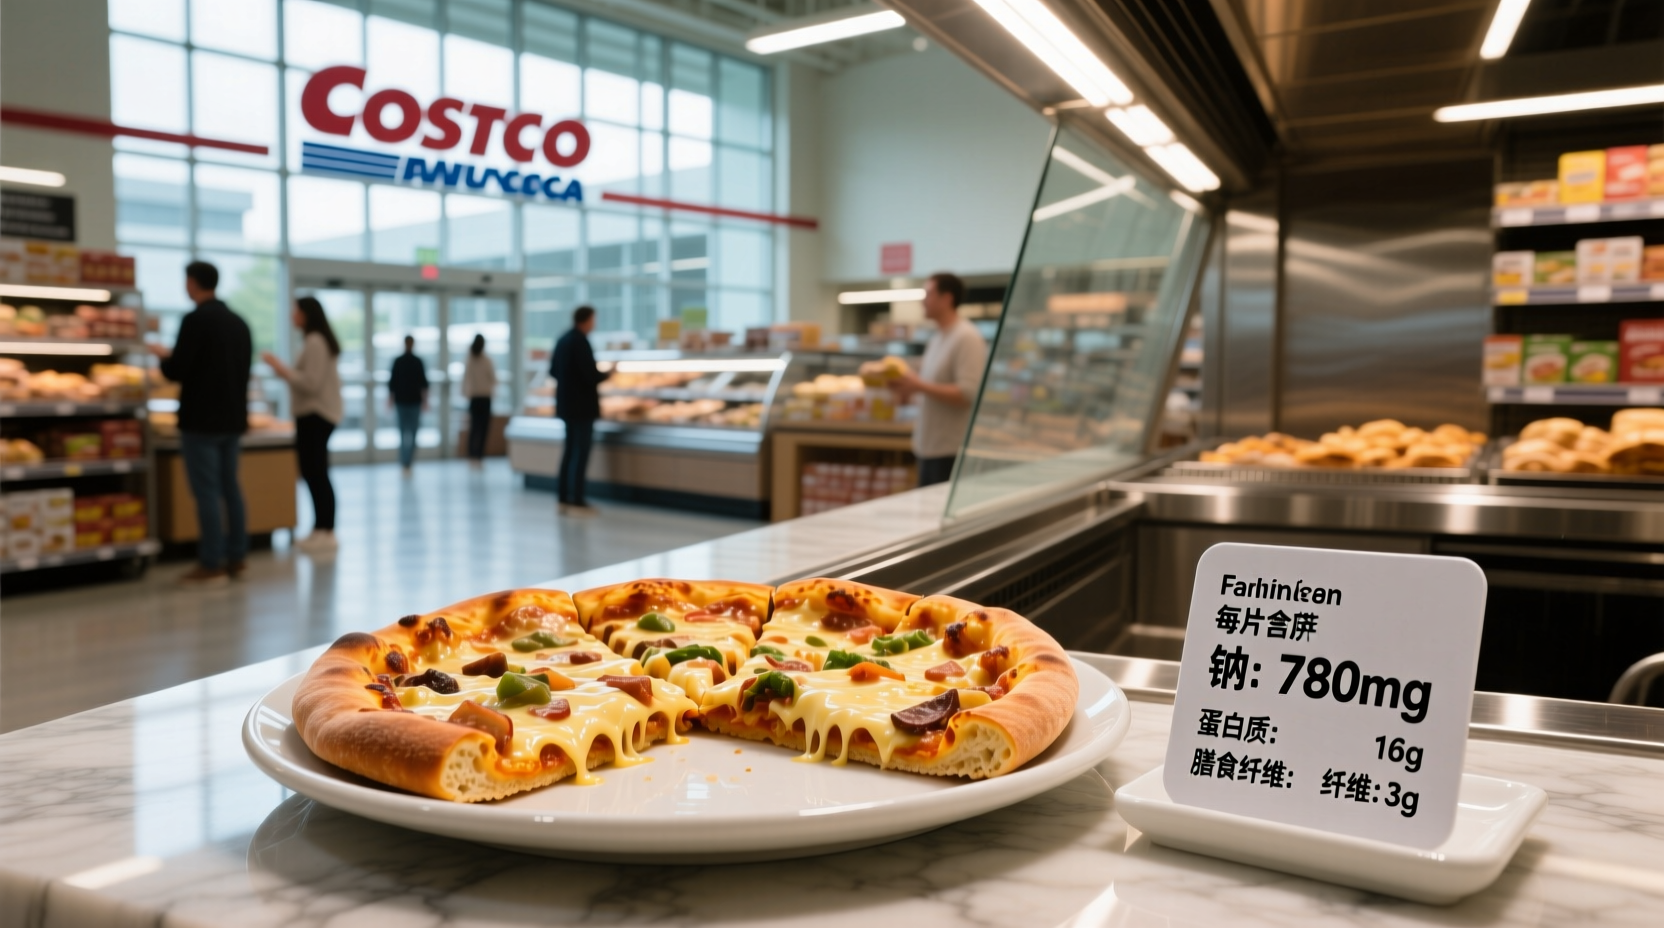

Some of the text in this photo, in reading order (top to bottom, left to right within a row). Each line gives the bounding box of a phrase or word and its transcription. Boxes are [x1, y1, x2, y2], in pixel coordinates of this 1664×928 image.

[302, 66, 590, 167] COSTCO
[1279, 654, 1432, 724] 780mg
[1198, 709, 1423, 773] 蛋白质: 16g
